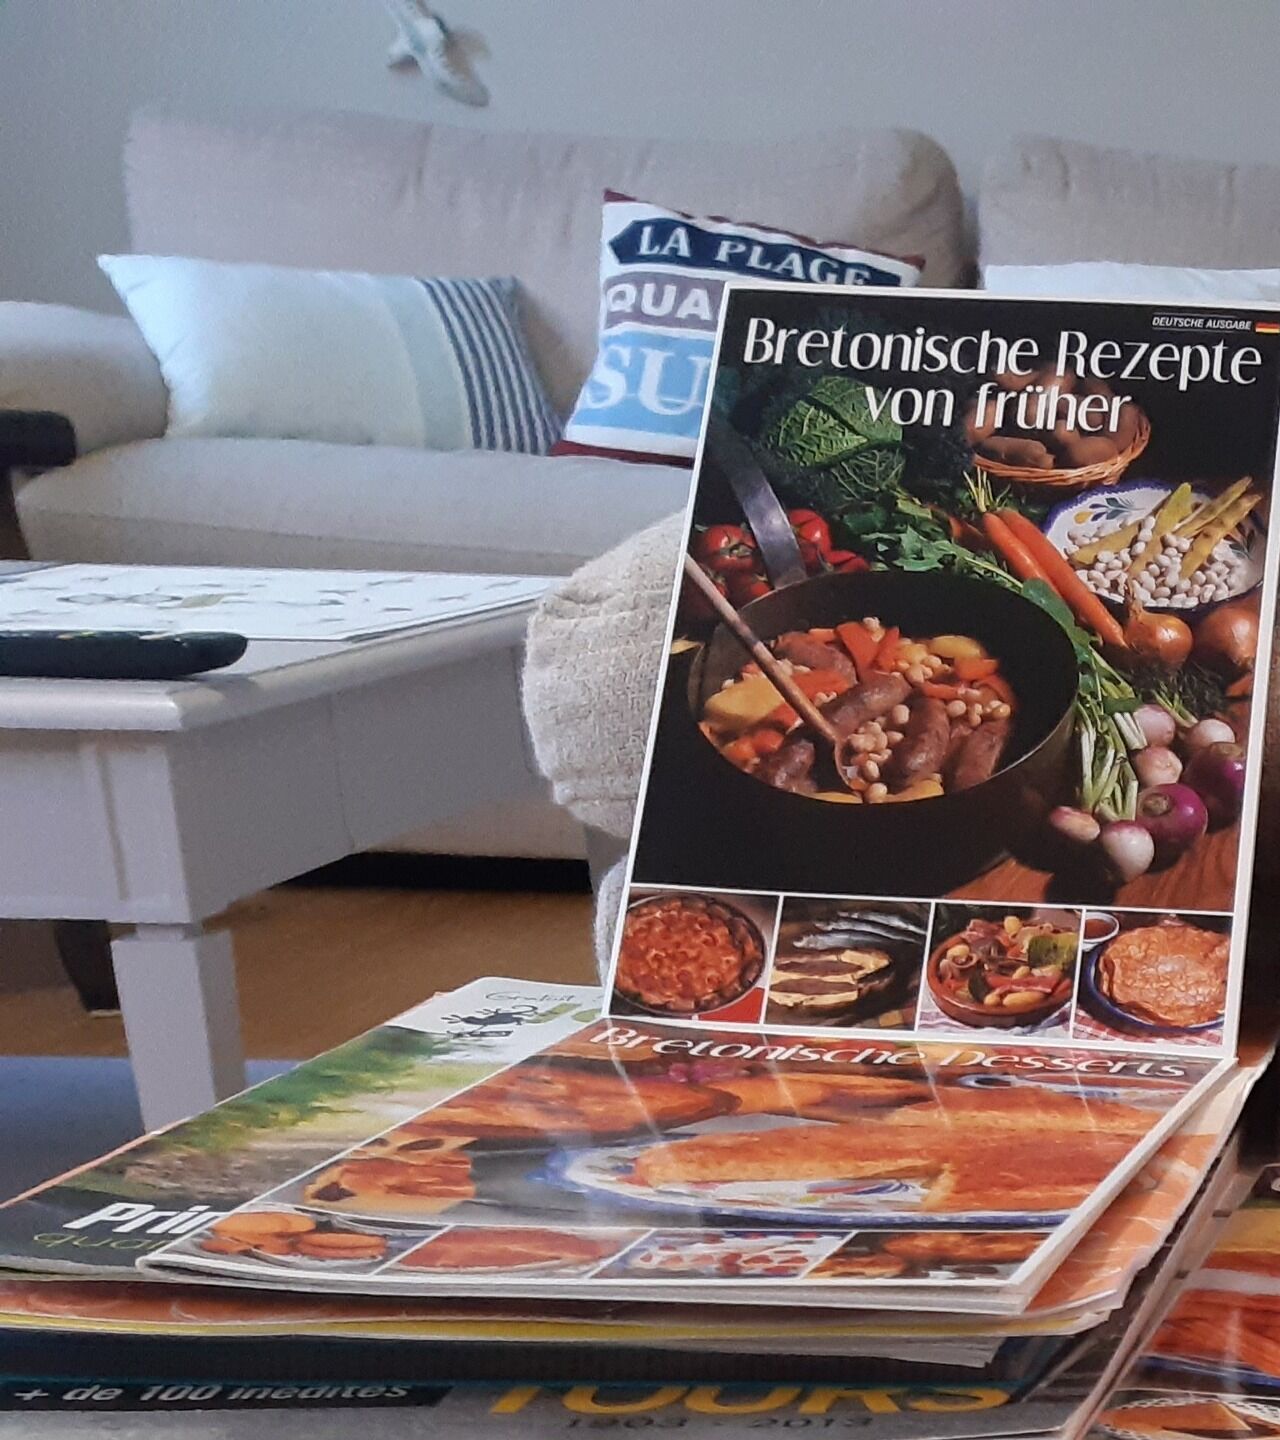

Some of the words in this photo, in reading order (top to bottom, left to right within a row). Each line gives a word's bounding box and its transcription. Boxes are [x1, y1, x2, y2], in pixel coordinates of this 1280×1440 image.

[637, 225, 691, 258] LA
[714, 239, 873, 286] PLAGE
[1152, 316, 1203, 328] DEUTSCHE
[1206, 318, 1252, 330] AUSGABE
[743, 317, 1040, 376] Bretonische
[1057, 330, 1263, 392] Rezepte
[865, 385, 954, 427] von
[975, 381, 1132, 433] früher
[589, 1026, 926, 1068] Bretonische
[937, 1048, 1187, 1080] Desserts
[62, 1384, 124, 1402] de
[140, 1384, 222, 1401] 100
